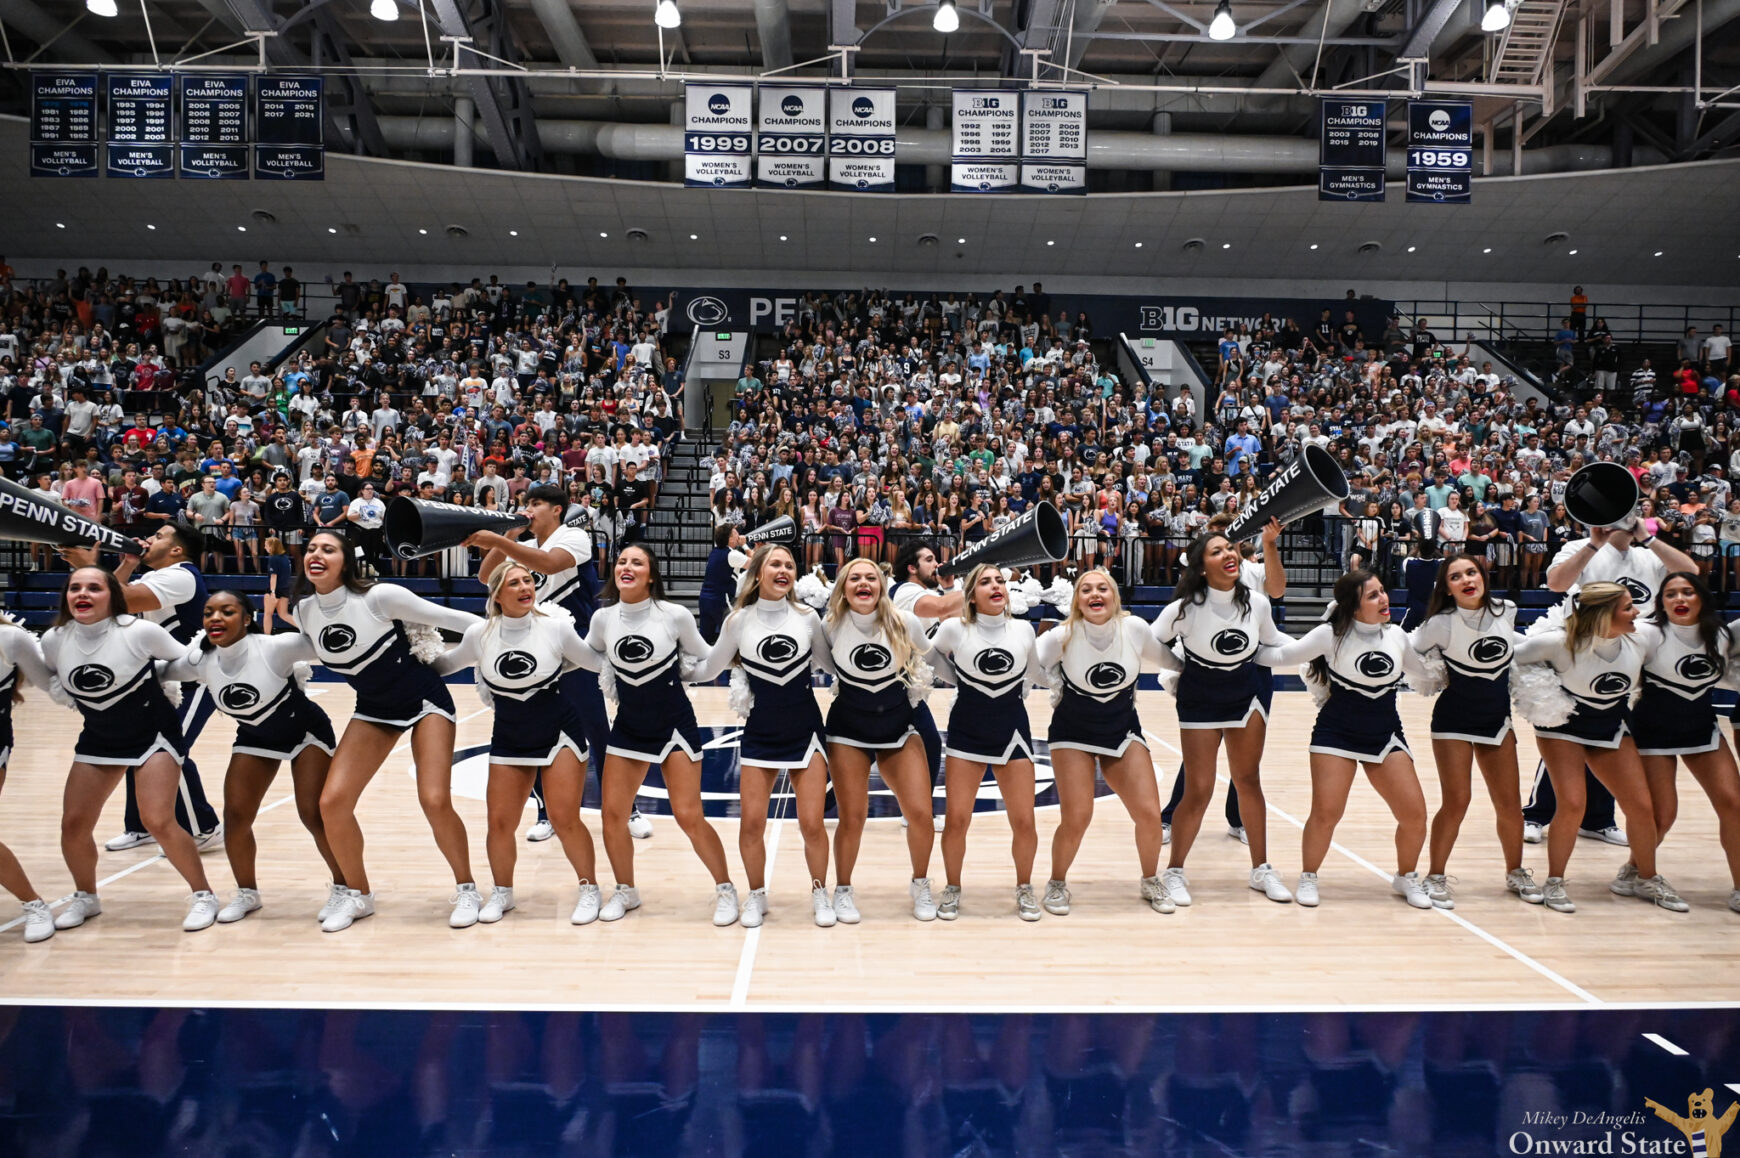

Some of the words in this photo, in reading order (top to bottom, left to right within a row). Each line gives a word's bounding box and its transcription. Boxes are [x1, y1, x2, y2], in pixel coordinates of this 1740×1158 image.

[1028, 110, 1082, 118] CHAMPIONS
[692, 117, 748, 125] CHAMPIONS
[765, 118, 821, 126] CHAMPIONS
[836, 119, 892, 127] CHAMPIONS
[1328, 118, 1381, 126] CHAMPIONS
[1414, 132, 1468, 140] CHAMPIONS
[690, 137, 748, 150] 1999
[760, 138, 823, 152] 2007
[831, 139, 895, 154] 2008
[1412, 152, 1468, 166] 1959
[1202, 317, 1286, 332] NETWOR
[718, 350, 730, 359] S3
[1142, 357, 1153, 366] S4
[904, 363, 910, 374] 9
[1260, 461, 1301, 505] STATE
[0, 493, 58, 527] PENN
[62, 515, 124, 548] STATE
[990, 510, 1033, 542] STATE
[748, 532, 768, 542] PENN
[770, 527, 792, 537] STATE
